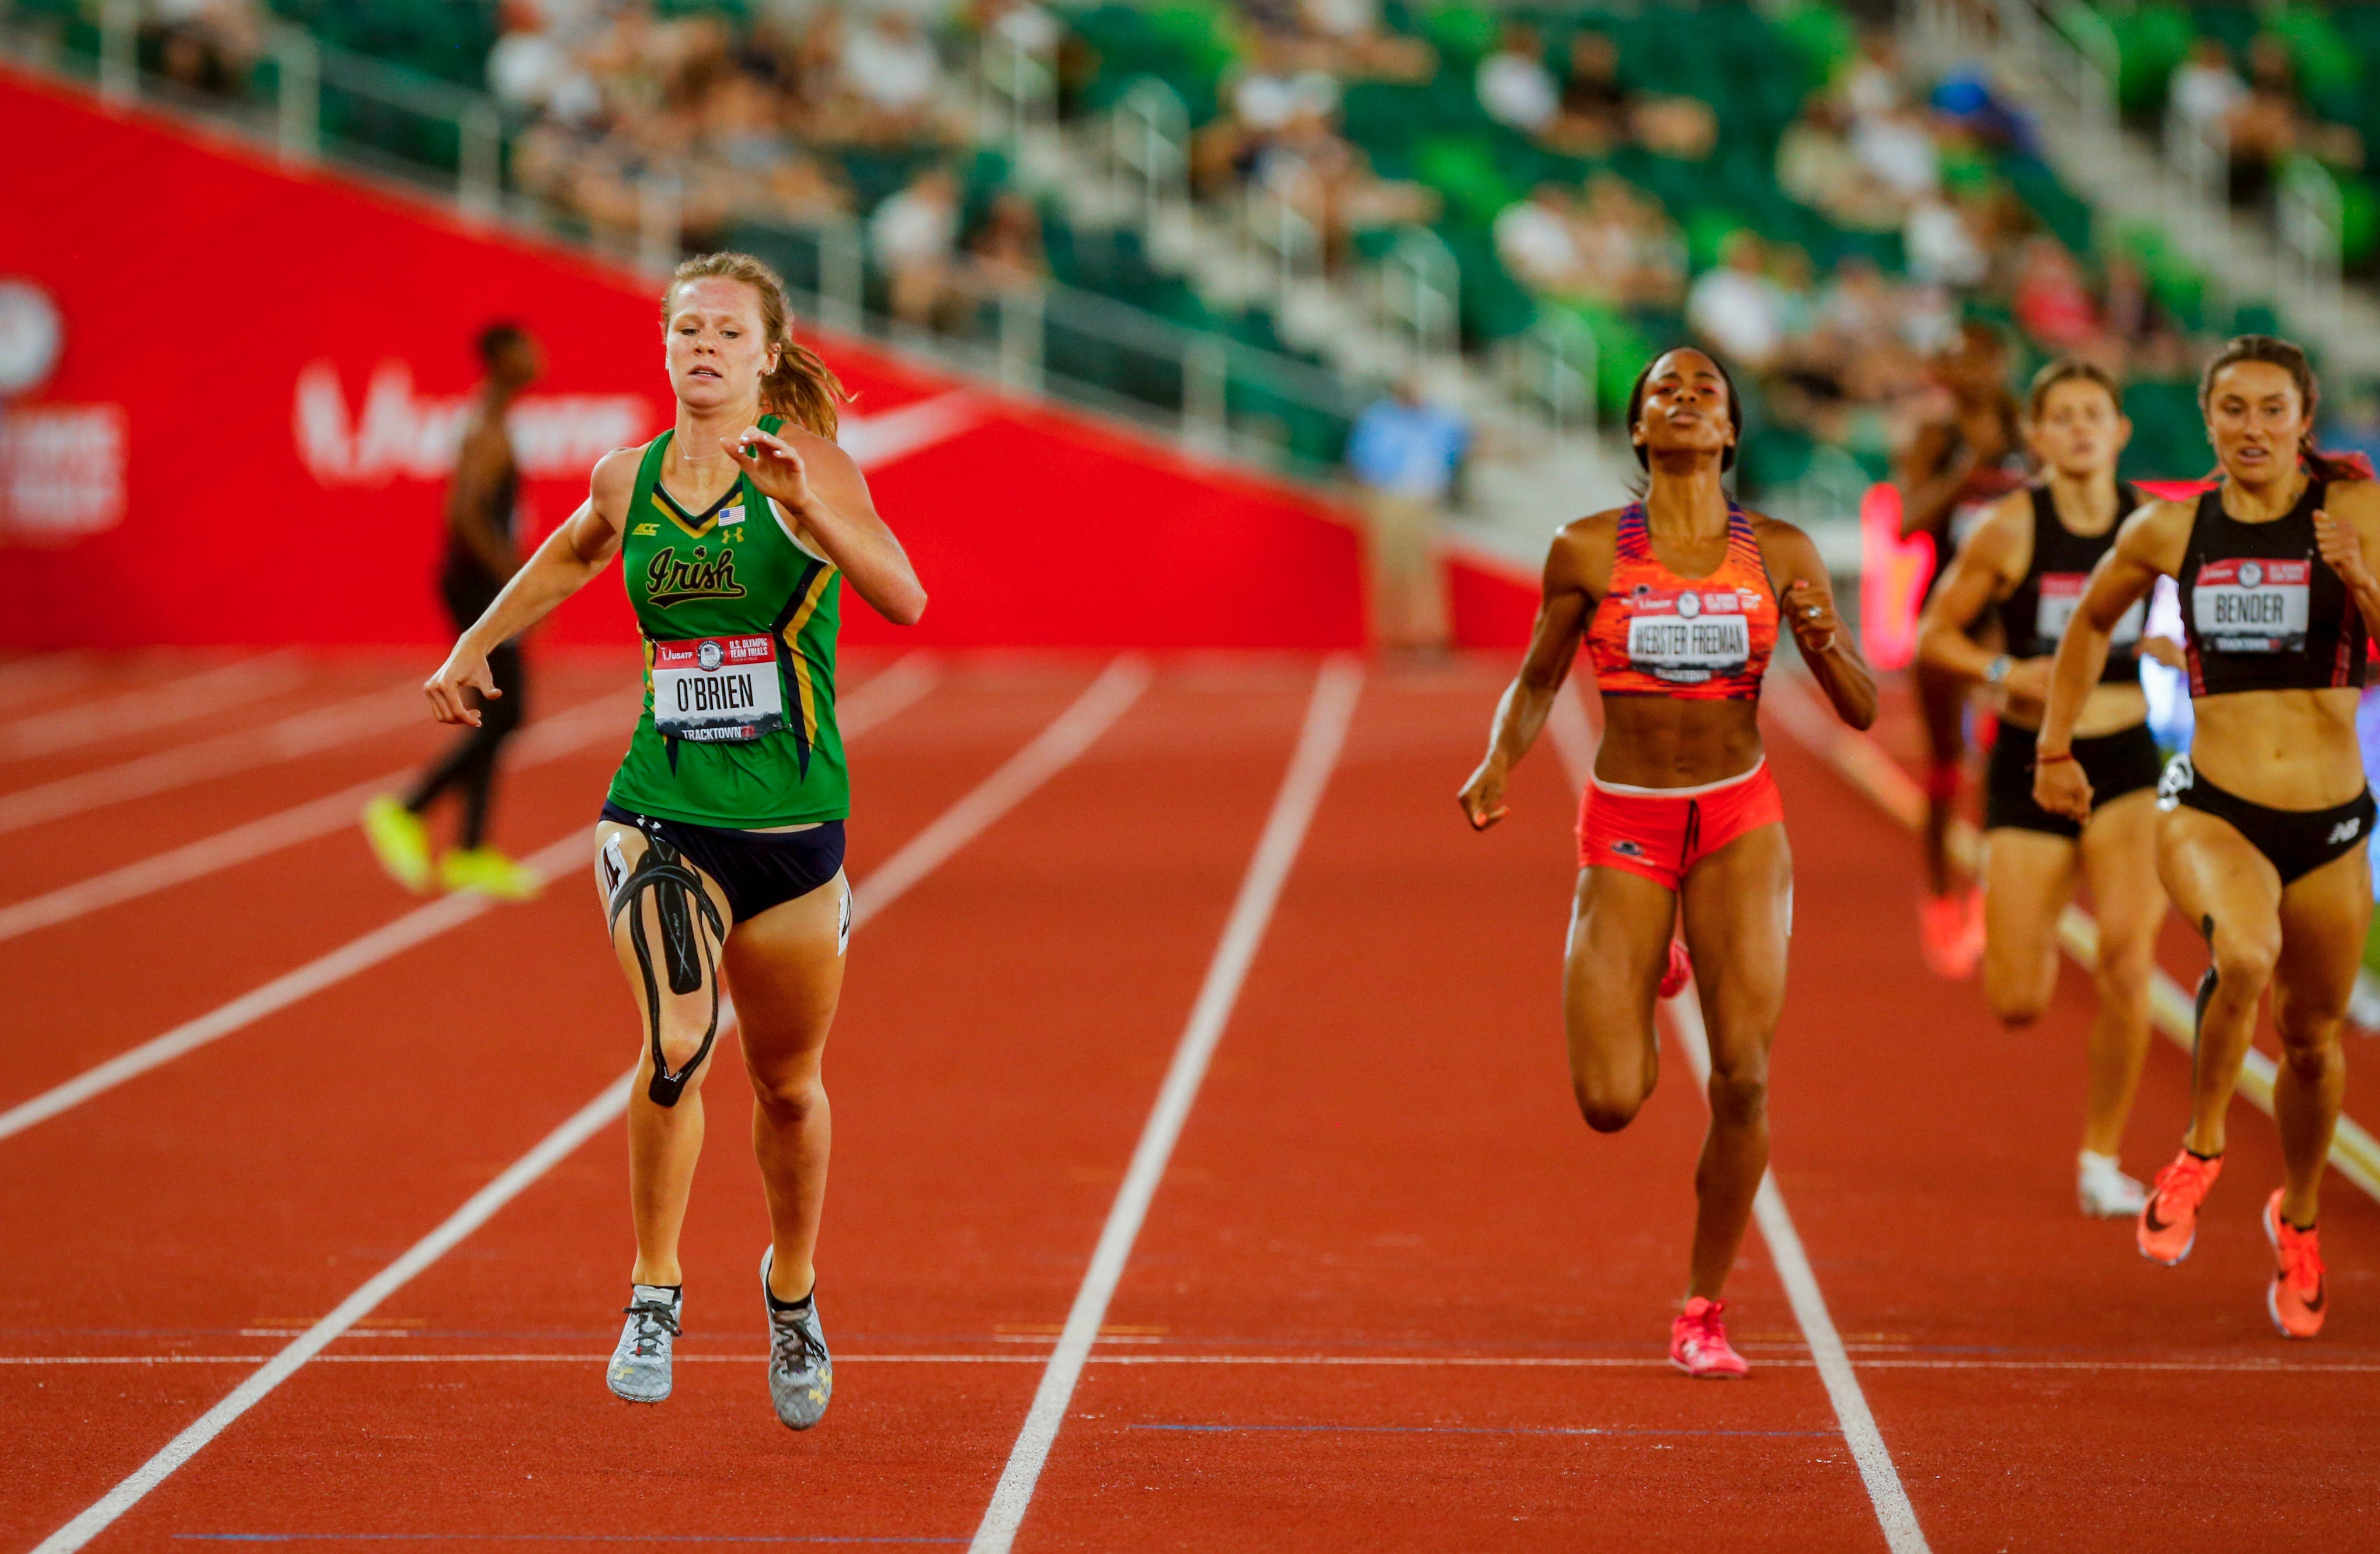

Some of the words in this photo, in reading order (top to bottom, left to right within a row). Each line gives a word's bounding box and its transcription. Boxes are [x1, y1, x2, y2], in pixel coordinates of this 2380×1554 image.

[632, 523, 660, 536] ACC
[646, 547, 746, 607] Irish
[2215, 594, 2284, 623] BENDER
[729, 640, 742, 649] U.S.
[742, 638, 768, 648] OLYMPIC
[1636, 625, 1687, 655] WEBSTER
[1693, 624, 1744, 654] FREEMAN
[671, 652, 693, 660] USATF
[730, 649, 748, 658] TEAM
[748, 646, 768, 657] TRIALS
[676, 674, 754, 712] O'BRIEN
